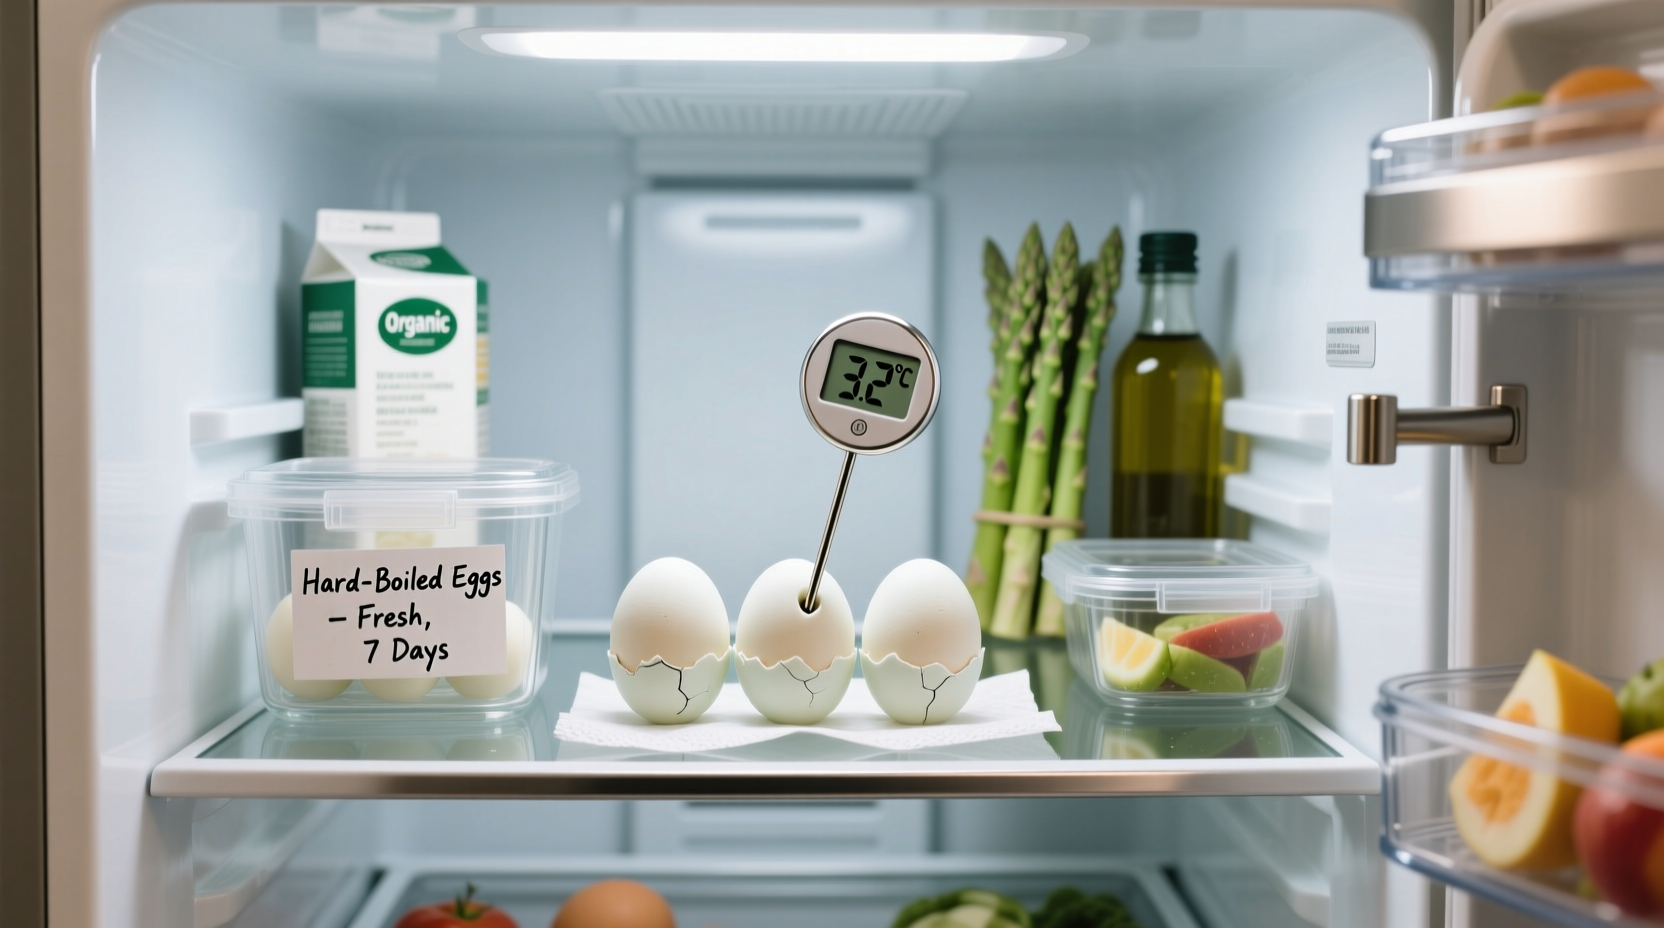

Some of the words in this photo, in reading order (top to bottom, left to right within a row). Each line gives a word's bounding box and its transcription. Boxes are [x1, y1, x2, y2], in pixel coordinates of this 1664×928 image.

[384, 309, 451, 339] Organic
[302, 564, 443, 595] Hard-Boiled
[452, 564, 502, 599] Eggs
[358, 602, 431, 631] Fresh,
[363, 639, 380, 664] 7
[392, 637, 449, 672] Days
